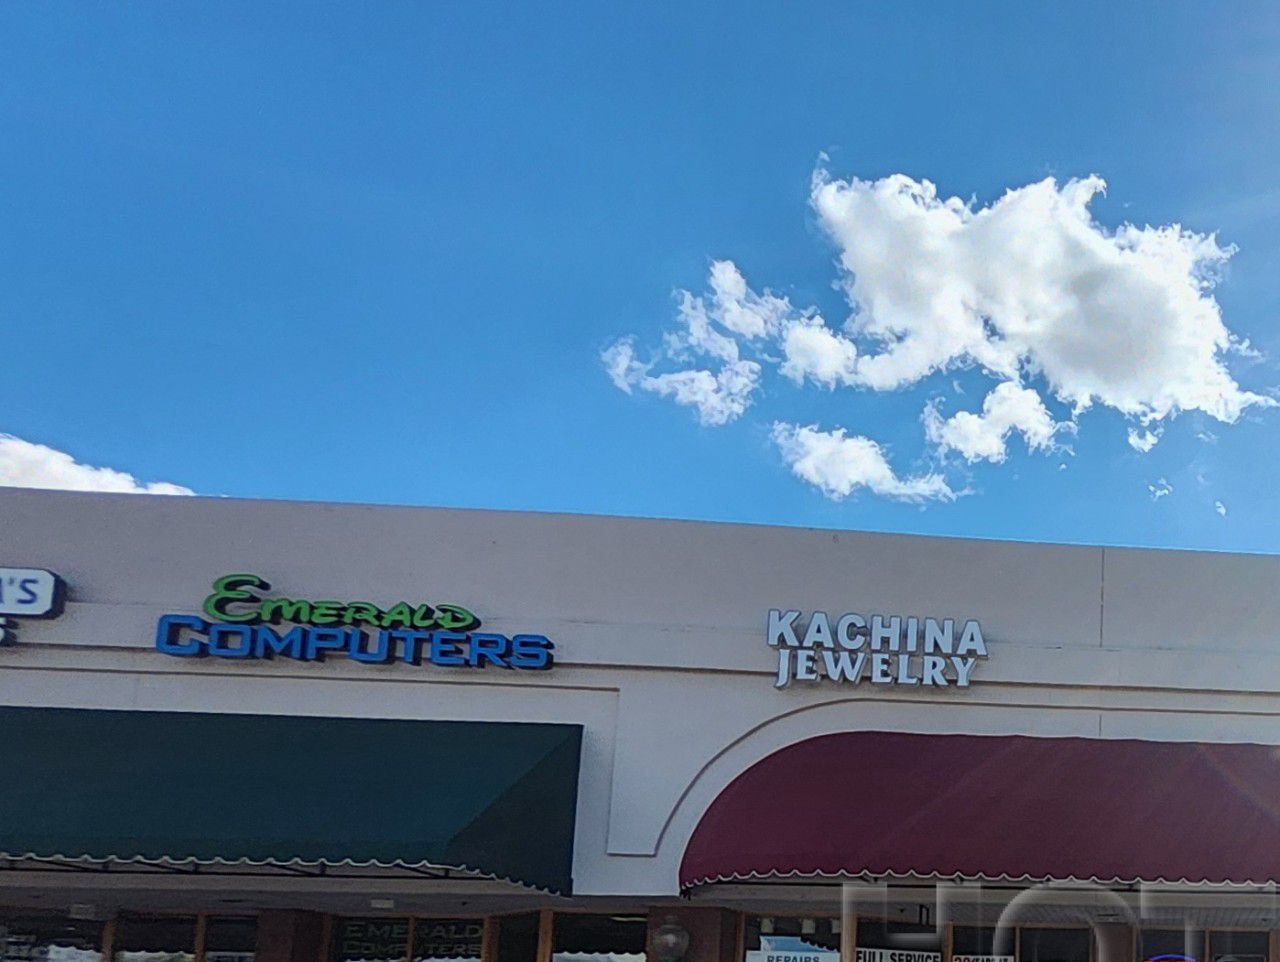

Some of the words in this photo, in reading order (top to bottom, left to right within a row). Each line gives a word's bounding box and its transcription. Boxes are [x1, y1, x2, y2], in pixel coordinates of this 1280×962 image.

[155, 613, 555, 670] COMPUTERS
[767, 609, 988, 657] KACHINA
[774, 649, 977, 688] JEWELRY
[346, 922, 482, 939] EMEALD
